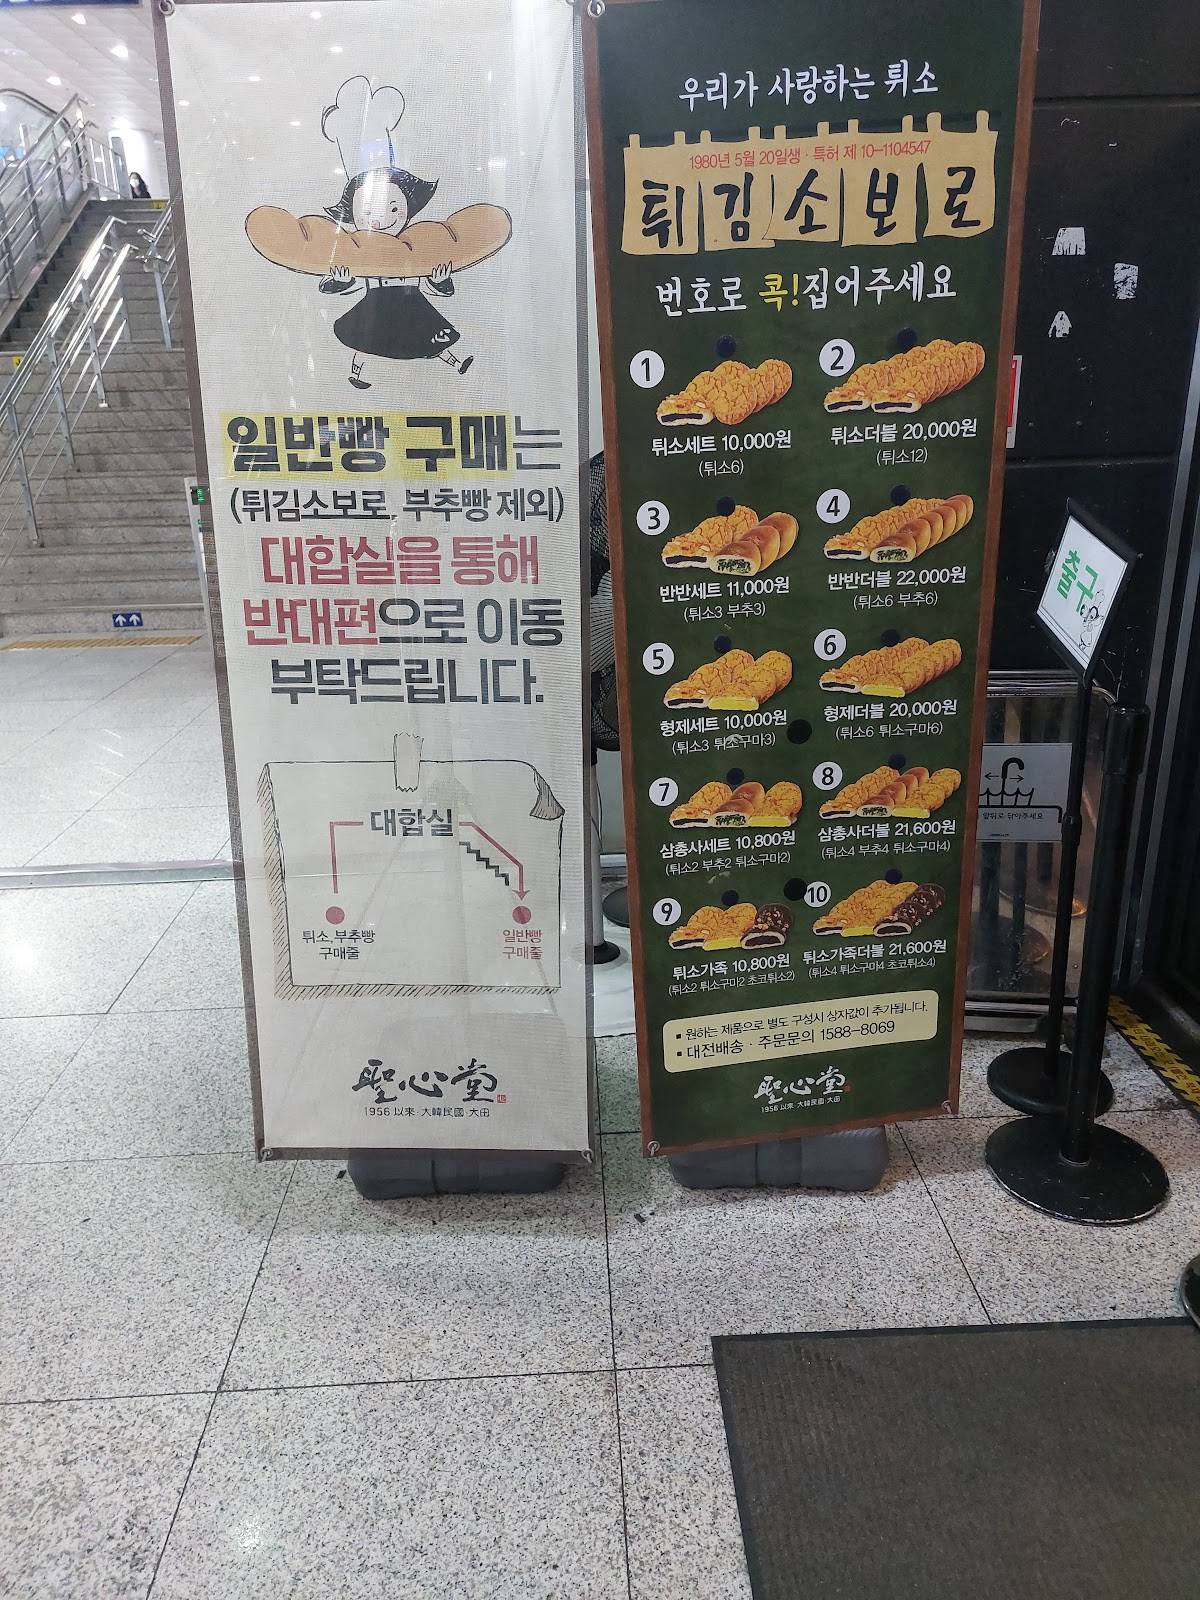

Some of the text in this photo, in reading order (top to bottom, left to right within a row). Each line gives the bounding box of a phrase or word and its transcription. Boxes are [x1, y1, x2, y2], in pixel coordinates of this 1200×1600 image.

[679, 59, 938, 112] 우리가 사랑하는 튀소
[690, 140, 931, 169] 1980년 5월 20일생 특허 제 10-1104547
[641, 166, 980, 249] 튀김소보로
[655, 276, 747, 318] 번호로
[641, 357, 650, 382] 1
[830, 345, 844, 371] 2
[226, 415, 563, 473] 일반빵 구매는
[651, 430, 792, 457] 튀소세트 10,000원
[830, 418, 977, 445] 튀소더블 20,000원
[698, 460, 744, 477] (튀소6)
[876, 447, 928, 466] (튀소12)
[402, 488, 492, 523] 부추빵
[496, 486, 564, 523] 제외)
[826, 495, 840, 517] 4
[647, 507, 661, 530] 3
[260, 533, 540, 586] 대합실을 통해
[659, 576, 790, 603] 반반세트 11,000원
[828, 565, 966, 591] 반반더블 22,000원
[1056, 549, 1099, 613] 출구
[683, 601, 766, 623] (튀소3 부추3)
[853, 591, 938, 610] (튀소6 부추6)
[242, 597, 565, 647] 반대편으로 이동
[823, 634, 837, 656] 6
[652, 649, 665, 670] 5
[270, 658, 544, 705] 부탁드립니다.
[659, 709, 787, 737] 형제세트 10,000원
[823, 699, 957, 722] 형제더블 20,000원
[835, 721, 944, 741] (튀소6 튀소구마6)
[672, 732, 776, 756] (튀소3 튀소구마3)
[821, 767, 834, 786] 8
[658, 782, 670, 802] 7
[370, 808, 454, 837] 대합실
[817, 819, 956, 843] 삼총사더블 21,600원
[659, 830, 796, 859] 삼총사세트 10,800원
[821, 840, 951, 861] (튀소4 부추4 튀소구마4)
[665, 851, 791, 876] (튀소2 부추2 튀소구마2)
[807, 885, 828, 903] 10
[661, 902, 673, 922] 9
[502, 929, 543, 944] 일반빵
[319, 946, 360, 961] 구매줄
[502, 946, 543, 961] 구매줄
[802, 939, 947, 965] 튀소가족더블 21,600원
[672, 953, 790, 981] 튀소가족 10,800원
[808, 956, 937, 979] (튀소4 튀소구마4 초코튀소4)
[668, 970, 796, 997] (튀소2 튀소구마2 초코튀소2)
[685, 1000, 928, 1041] 원하는 제품으로 별도 구성시 상자값이 추가됩니다.
[687, 1020, 895, 1059] 대전배송 주문문의 1588-8069
[364, 1107, 391, 1117] 1956
[761, 1105, 779, 1113] 1956
